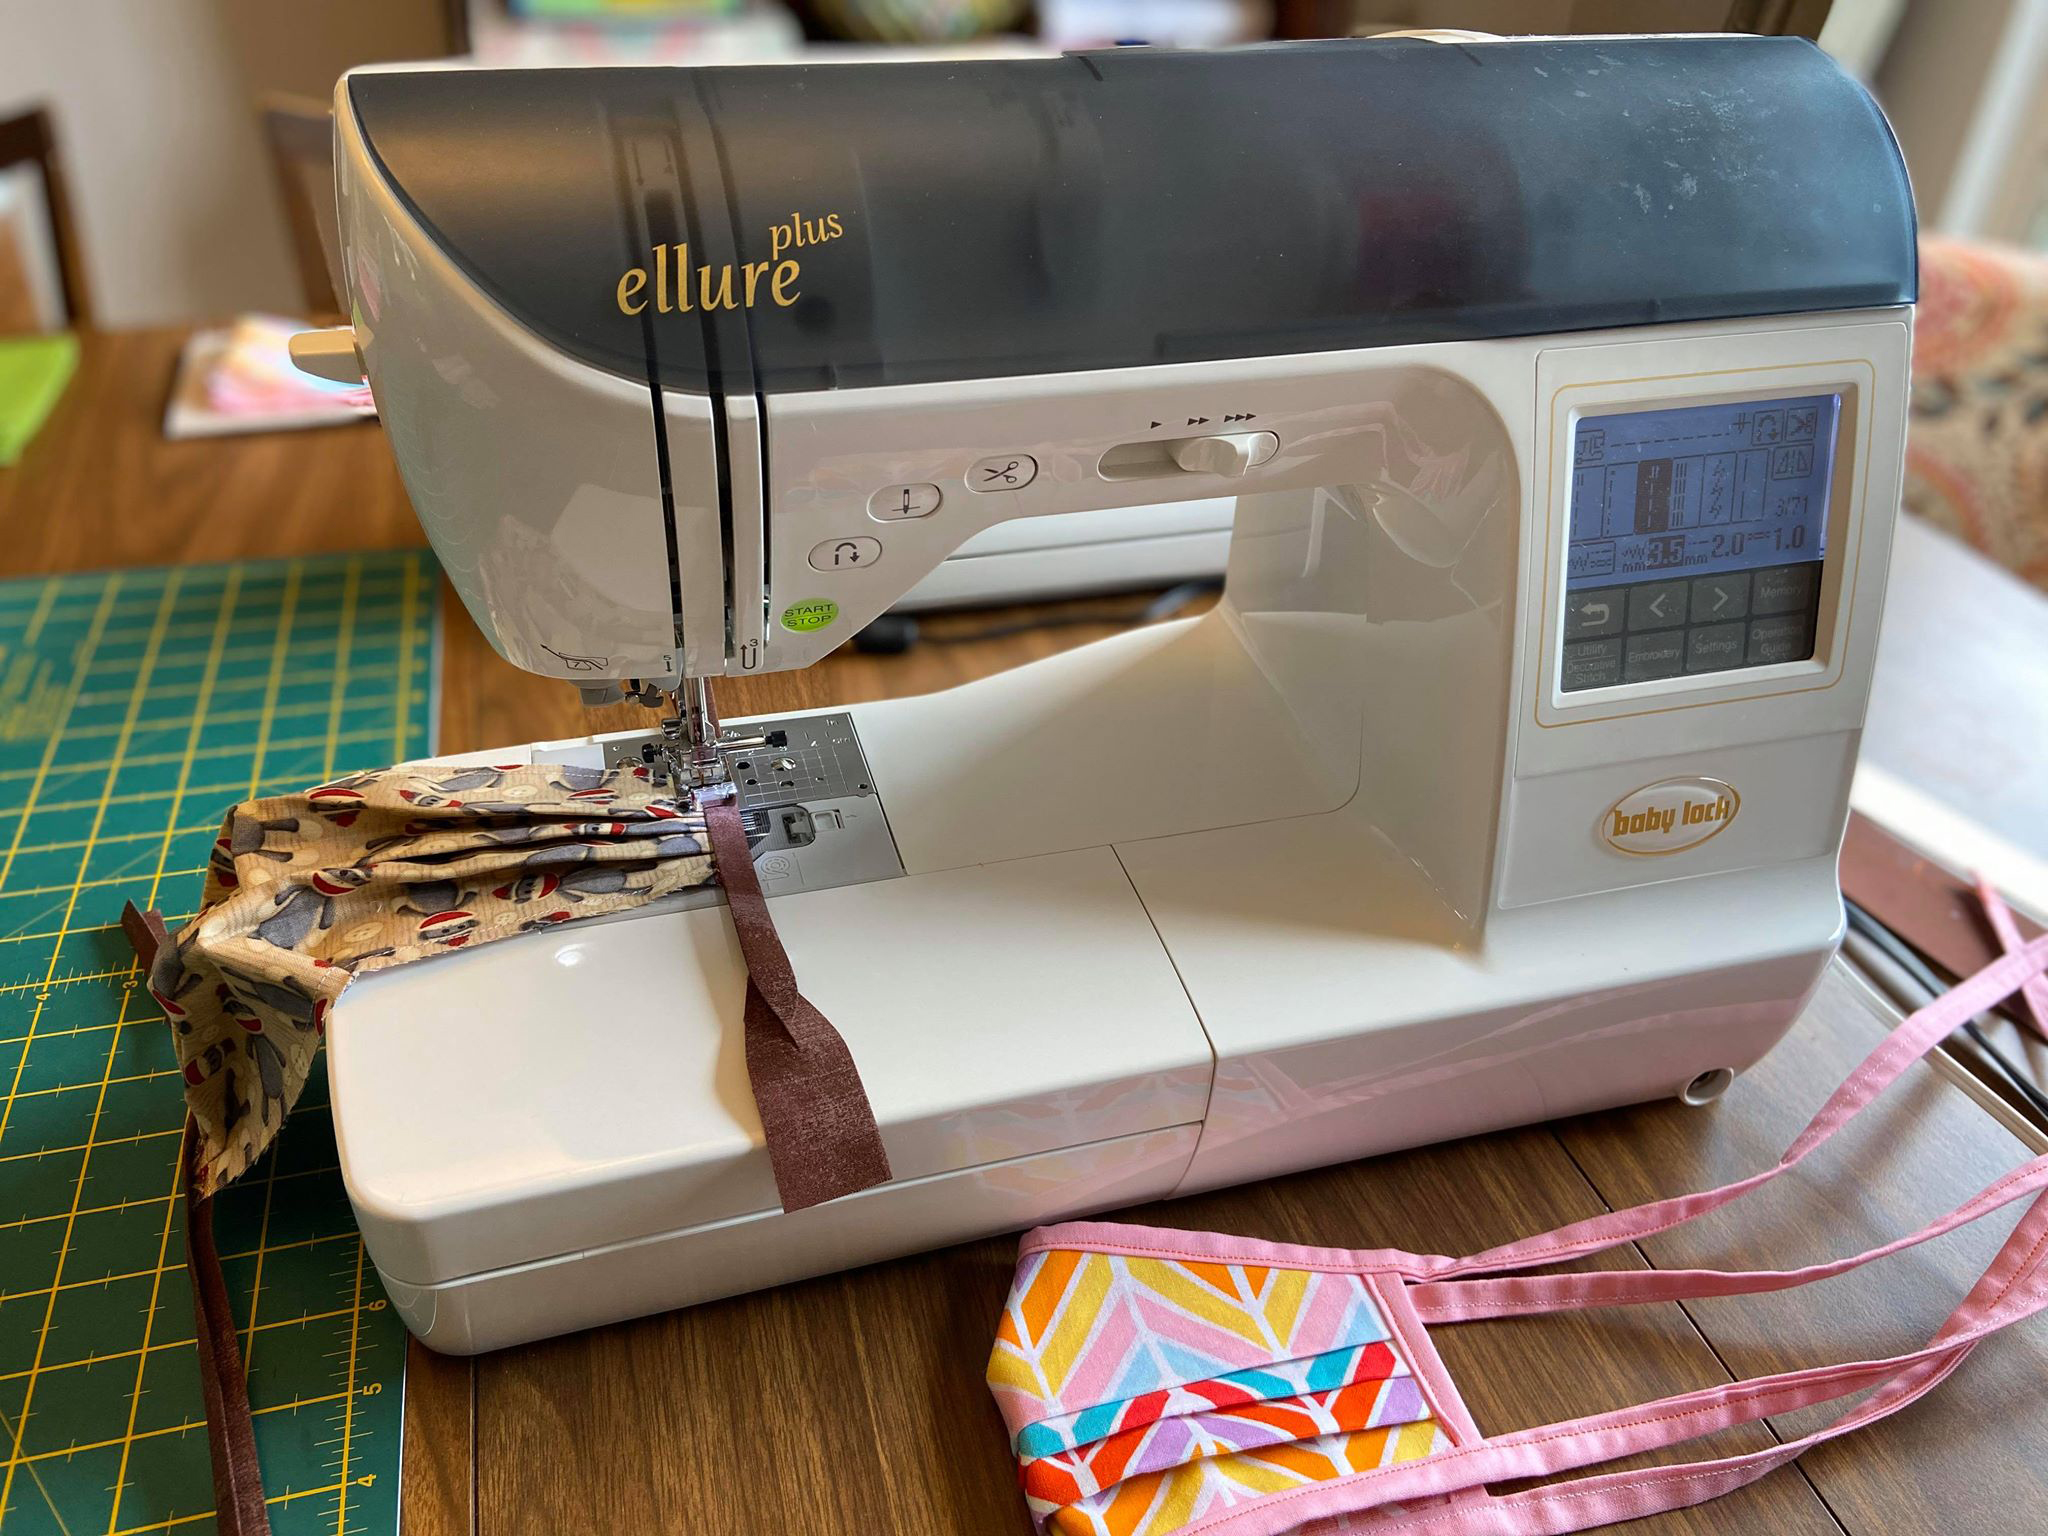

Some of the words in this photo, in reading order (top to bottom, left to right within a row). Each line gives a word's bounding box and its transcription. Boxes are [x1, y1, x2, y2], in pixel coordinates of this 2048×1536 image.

[768, 211, 844, 261] plus
[616, 242, 802, 316] ellure
[1775, 525, 1806, 551] 1.0
[1649, 537, 1685, 567] 3.5
[1711, 532, 1744, 558] 2.0
[784, 603, 834, 617] START
[787, 614, 832, 627] STOP
[749, 638, 759, 648] 3
[1577, 643, 1608, 657] Utility
[1695, 638, 1738, 655] Settings
[1613, 806, 1676, 837] baby
[1682, 795, 1731, 826] lock
[122, 980, 138, 989] 3
[367, 1299, 387, 1312] 6
[362, 1382, 382, 1397] 5
[356, 1473, 377, 1487] 4
